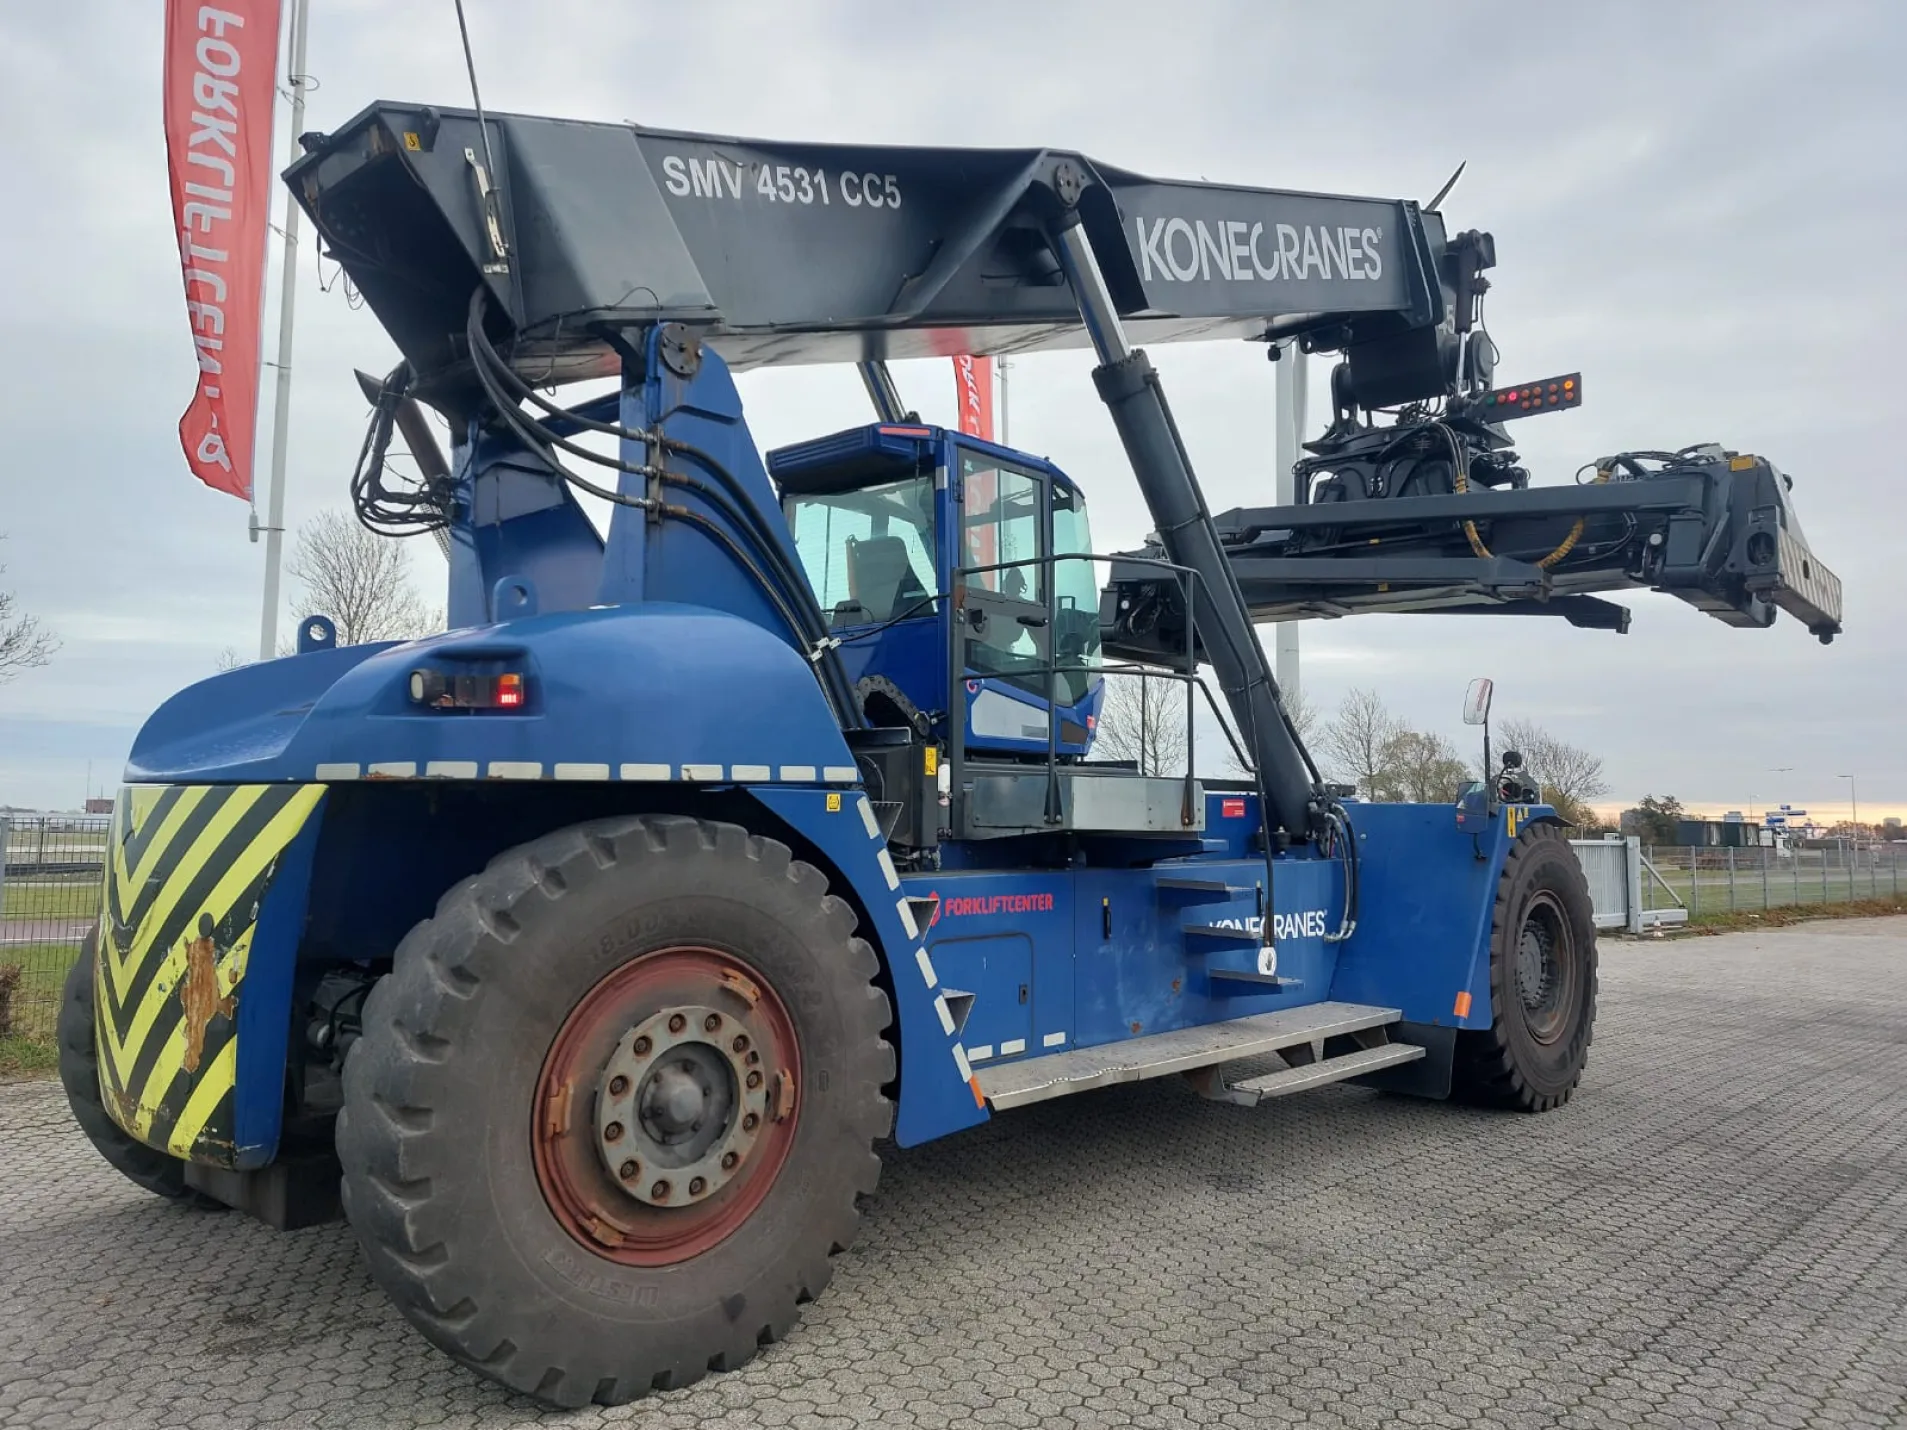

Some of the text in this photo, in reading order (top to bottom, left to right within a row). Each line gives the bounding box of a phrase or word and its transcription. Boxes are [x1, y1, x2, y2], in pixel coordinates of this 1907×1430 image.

[662, 155, 902, 210] SMV 4531 CC5
[1136, 216, 1382, 282] KONECRANES
[944, 892, 1054, 918] FORKLIFTCENTER
